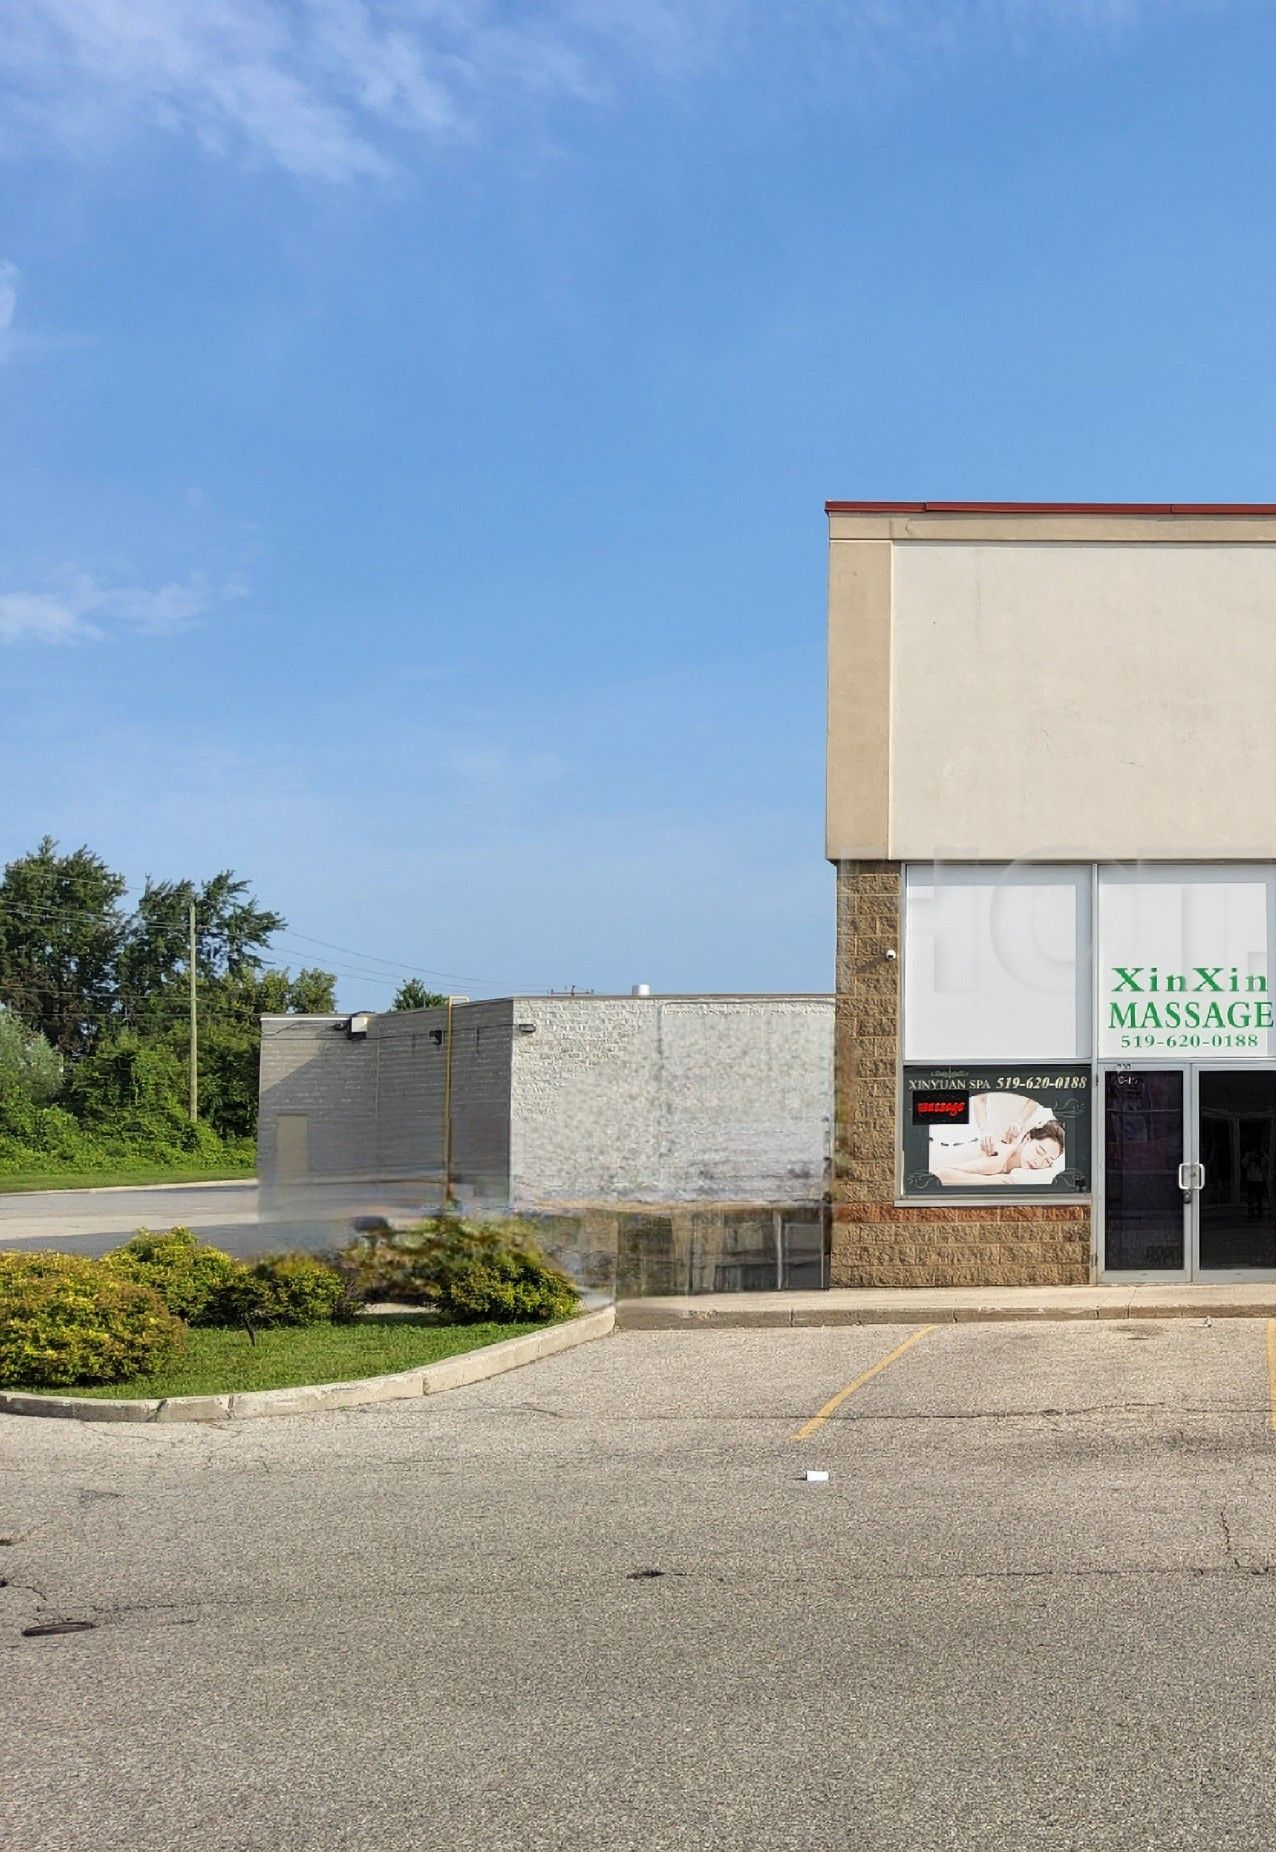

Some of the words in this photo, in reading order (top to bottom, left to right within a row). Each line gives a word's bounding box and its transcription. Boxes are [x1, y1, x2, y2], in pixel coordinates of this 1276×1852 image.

[1111, 967, 1269, 992] XinXin
[1108, 1001, 1274, 1029] MASSAGE
[1121, 1034, 1258, 1048] 519-620-0188
[908, 1079, 967, 1090] XINYUAN
[969, 1079, 991, 1090] SPA
[995, 1076, 1088, 1089] 519-620-0188
